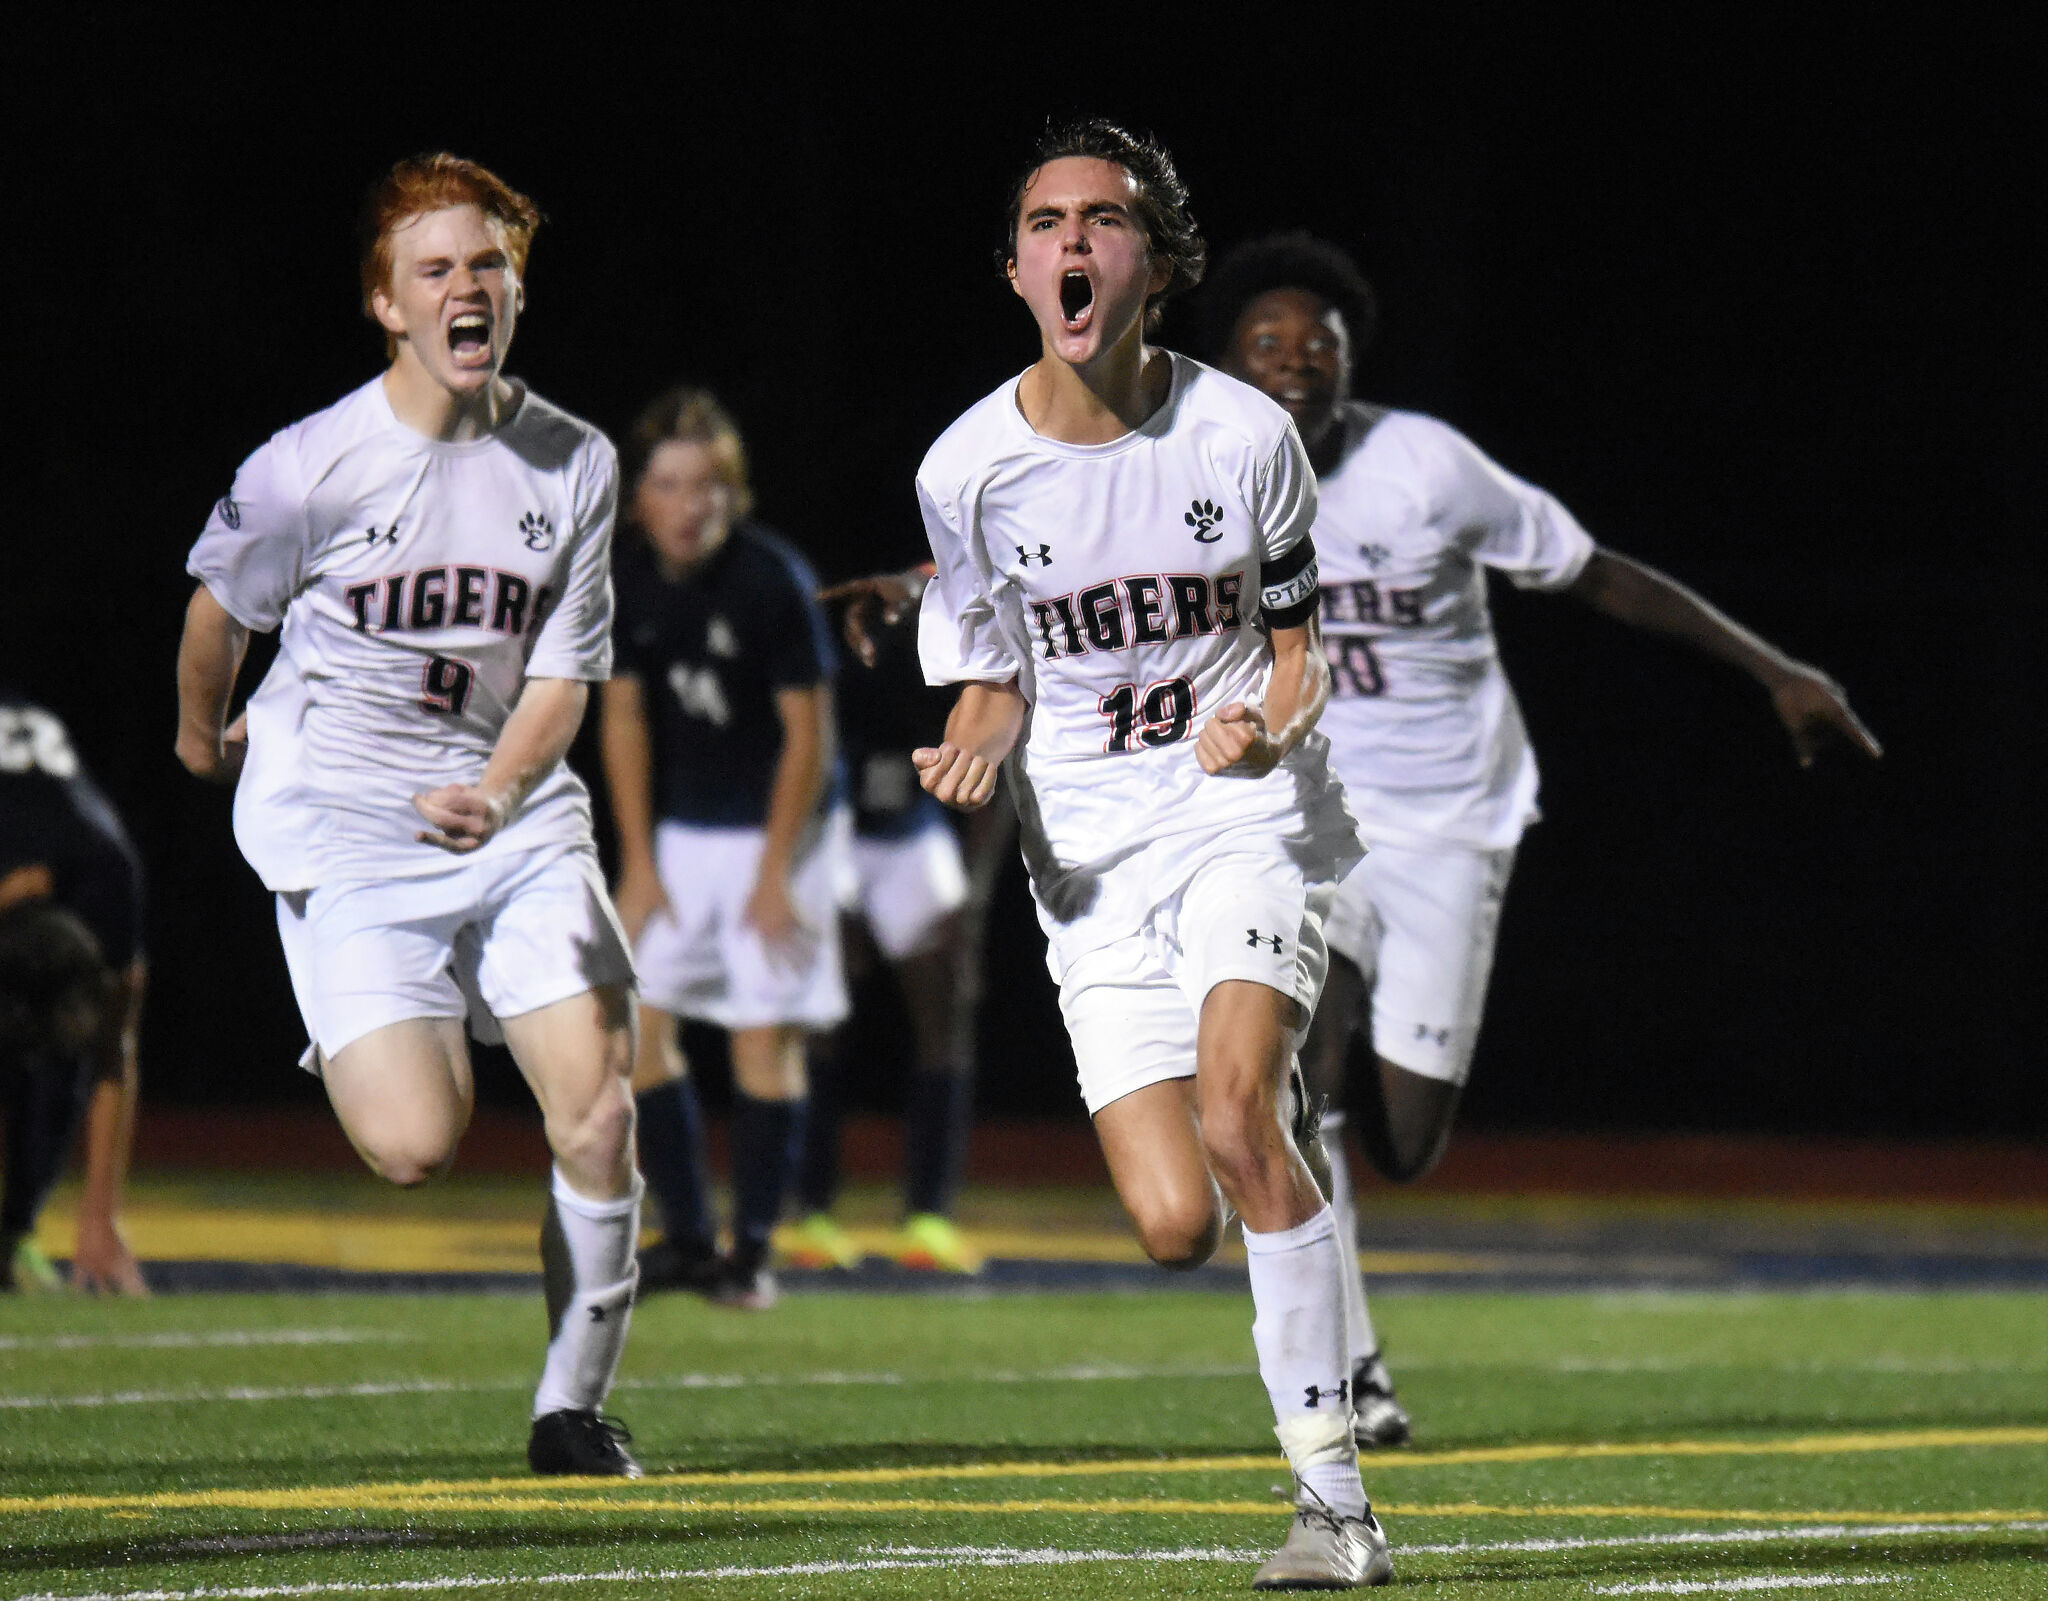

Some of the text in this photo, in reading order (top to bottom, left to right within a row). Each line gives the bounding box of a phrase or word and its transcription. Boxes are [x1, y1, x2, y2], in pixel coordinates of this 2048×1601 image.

[1029, 571, 1244, 661] TIGERS
[1265, 564, 1318, 608] PTAIN
[1319, 579, 1425, 627] ERS
[419, 654, 474, 717] 9
[1098, 675, 1198, 754] 19
